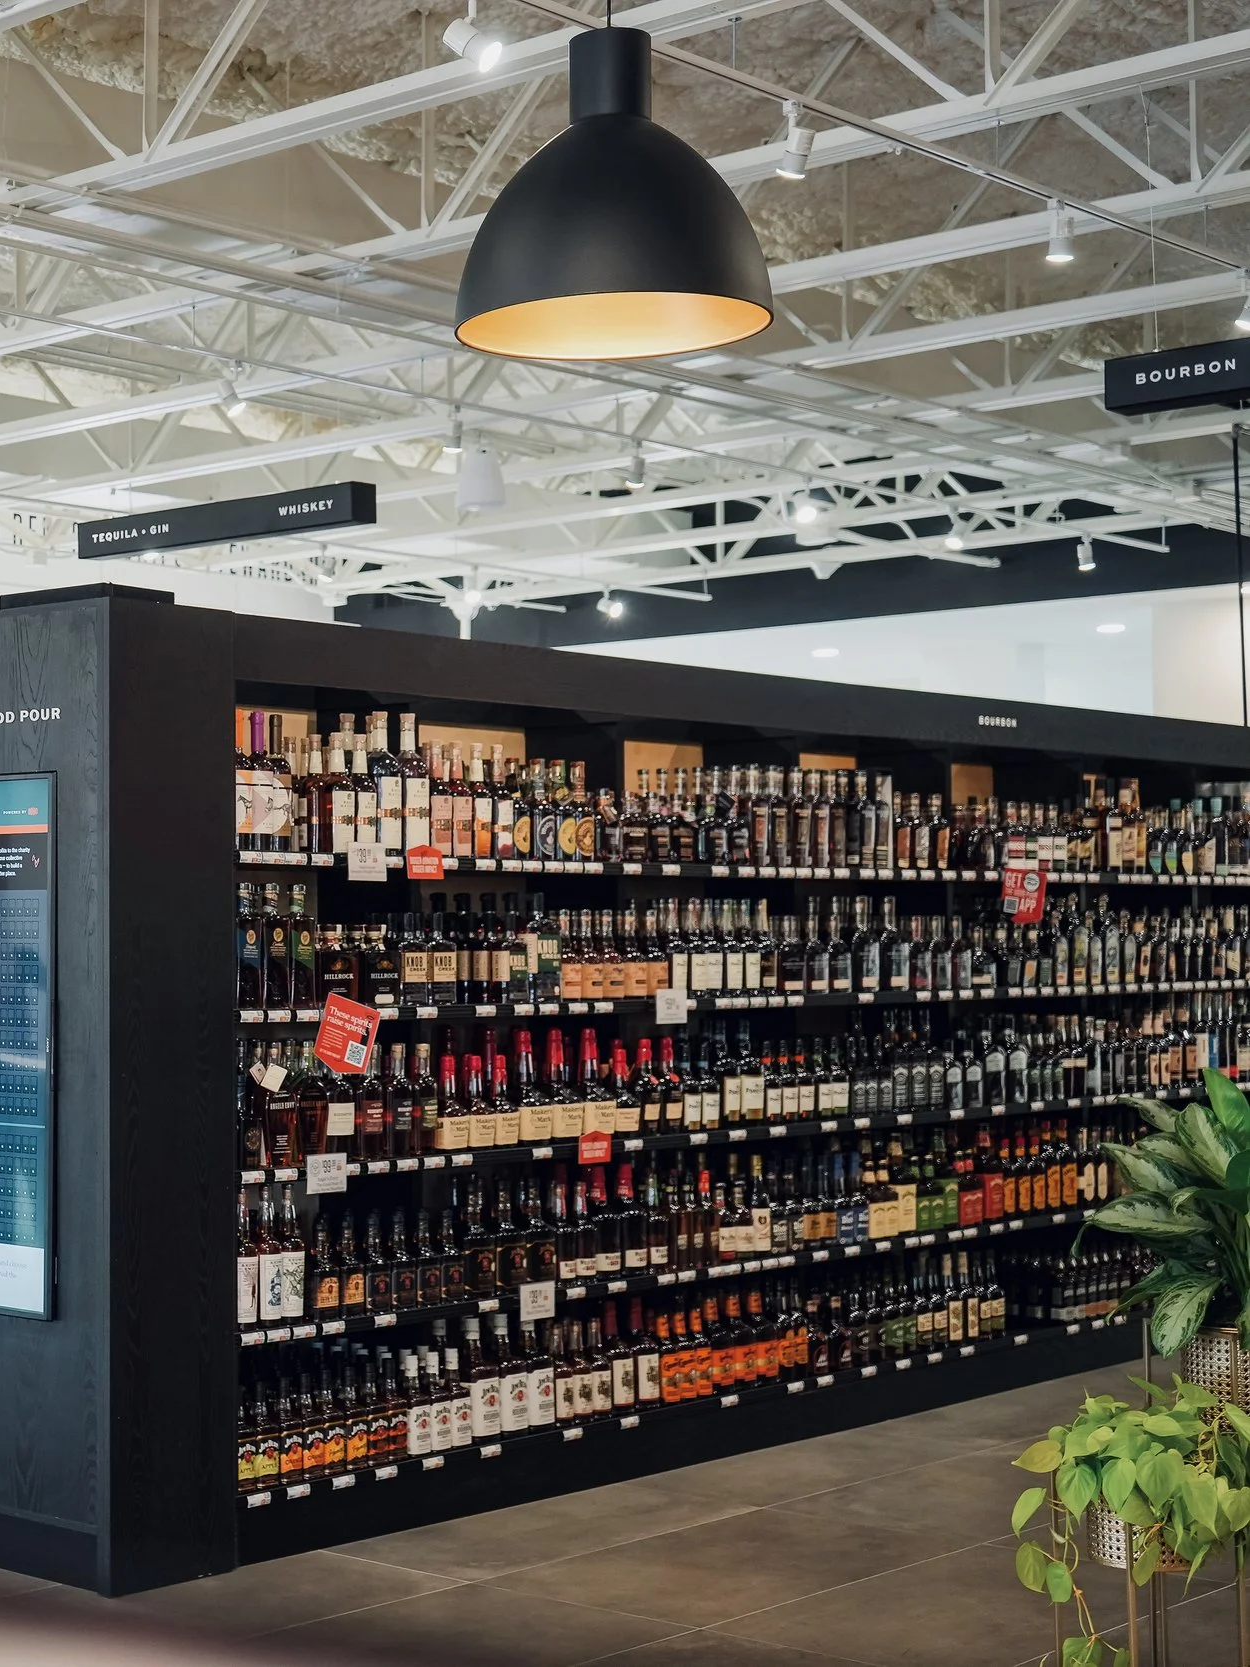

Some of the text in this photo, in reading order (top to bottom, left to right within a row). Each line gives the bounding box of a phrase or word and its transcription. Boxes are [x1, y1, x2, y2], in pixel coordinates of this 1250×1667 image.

[1136, 359, 1236, 384] BOURBON
[278, 499, 333, 516] WHISKEY
[92, 524, 169, 543] TEQUILA GIN
[20, 708, 61, 722] POUR
[978, 715, 1017, 728] BOURBON
[406, 956, 423, 967] KNOB
[435, 956, 452, 967] KNOB
[327, 1016, 344, 1026] raise
[330, 1006, 372, 1029] These spirits
